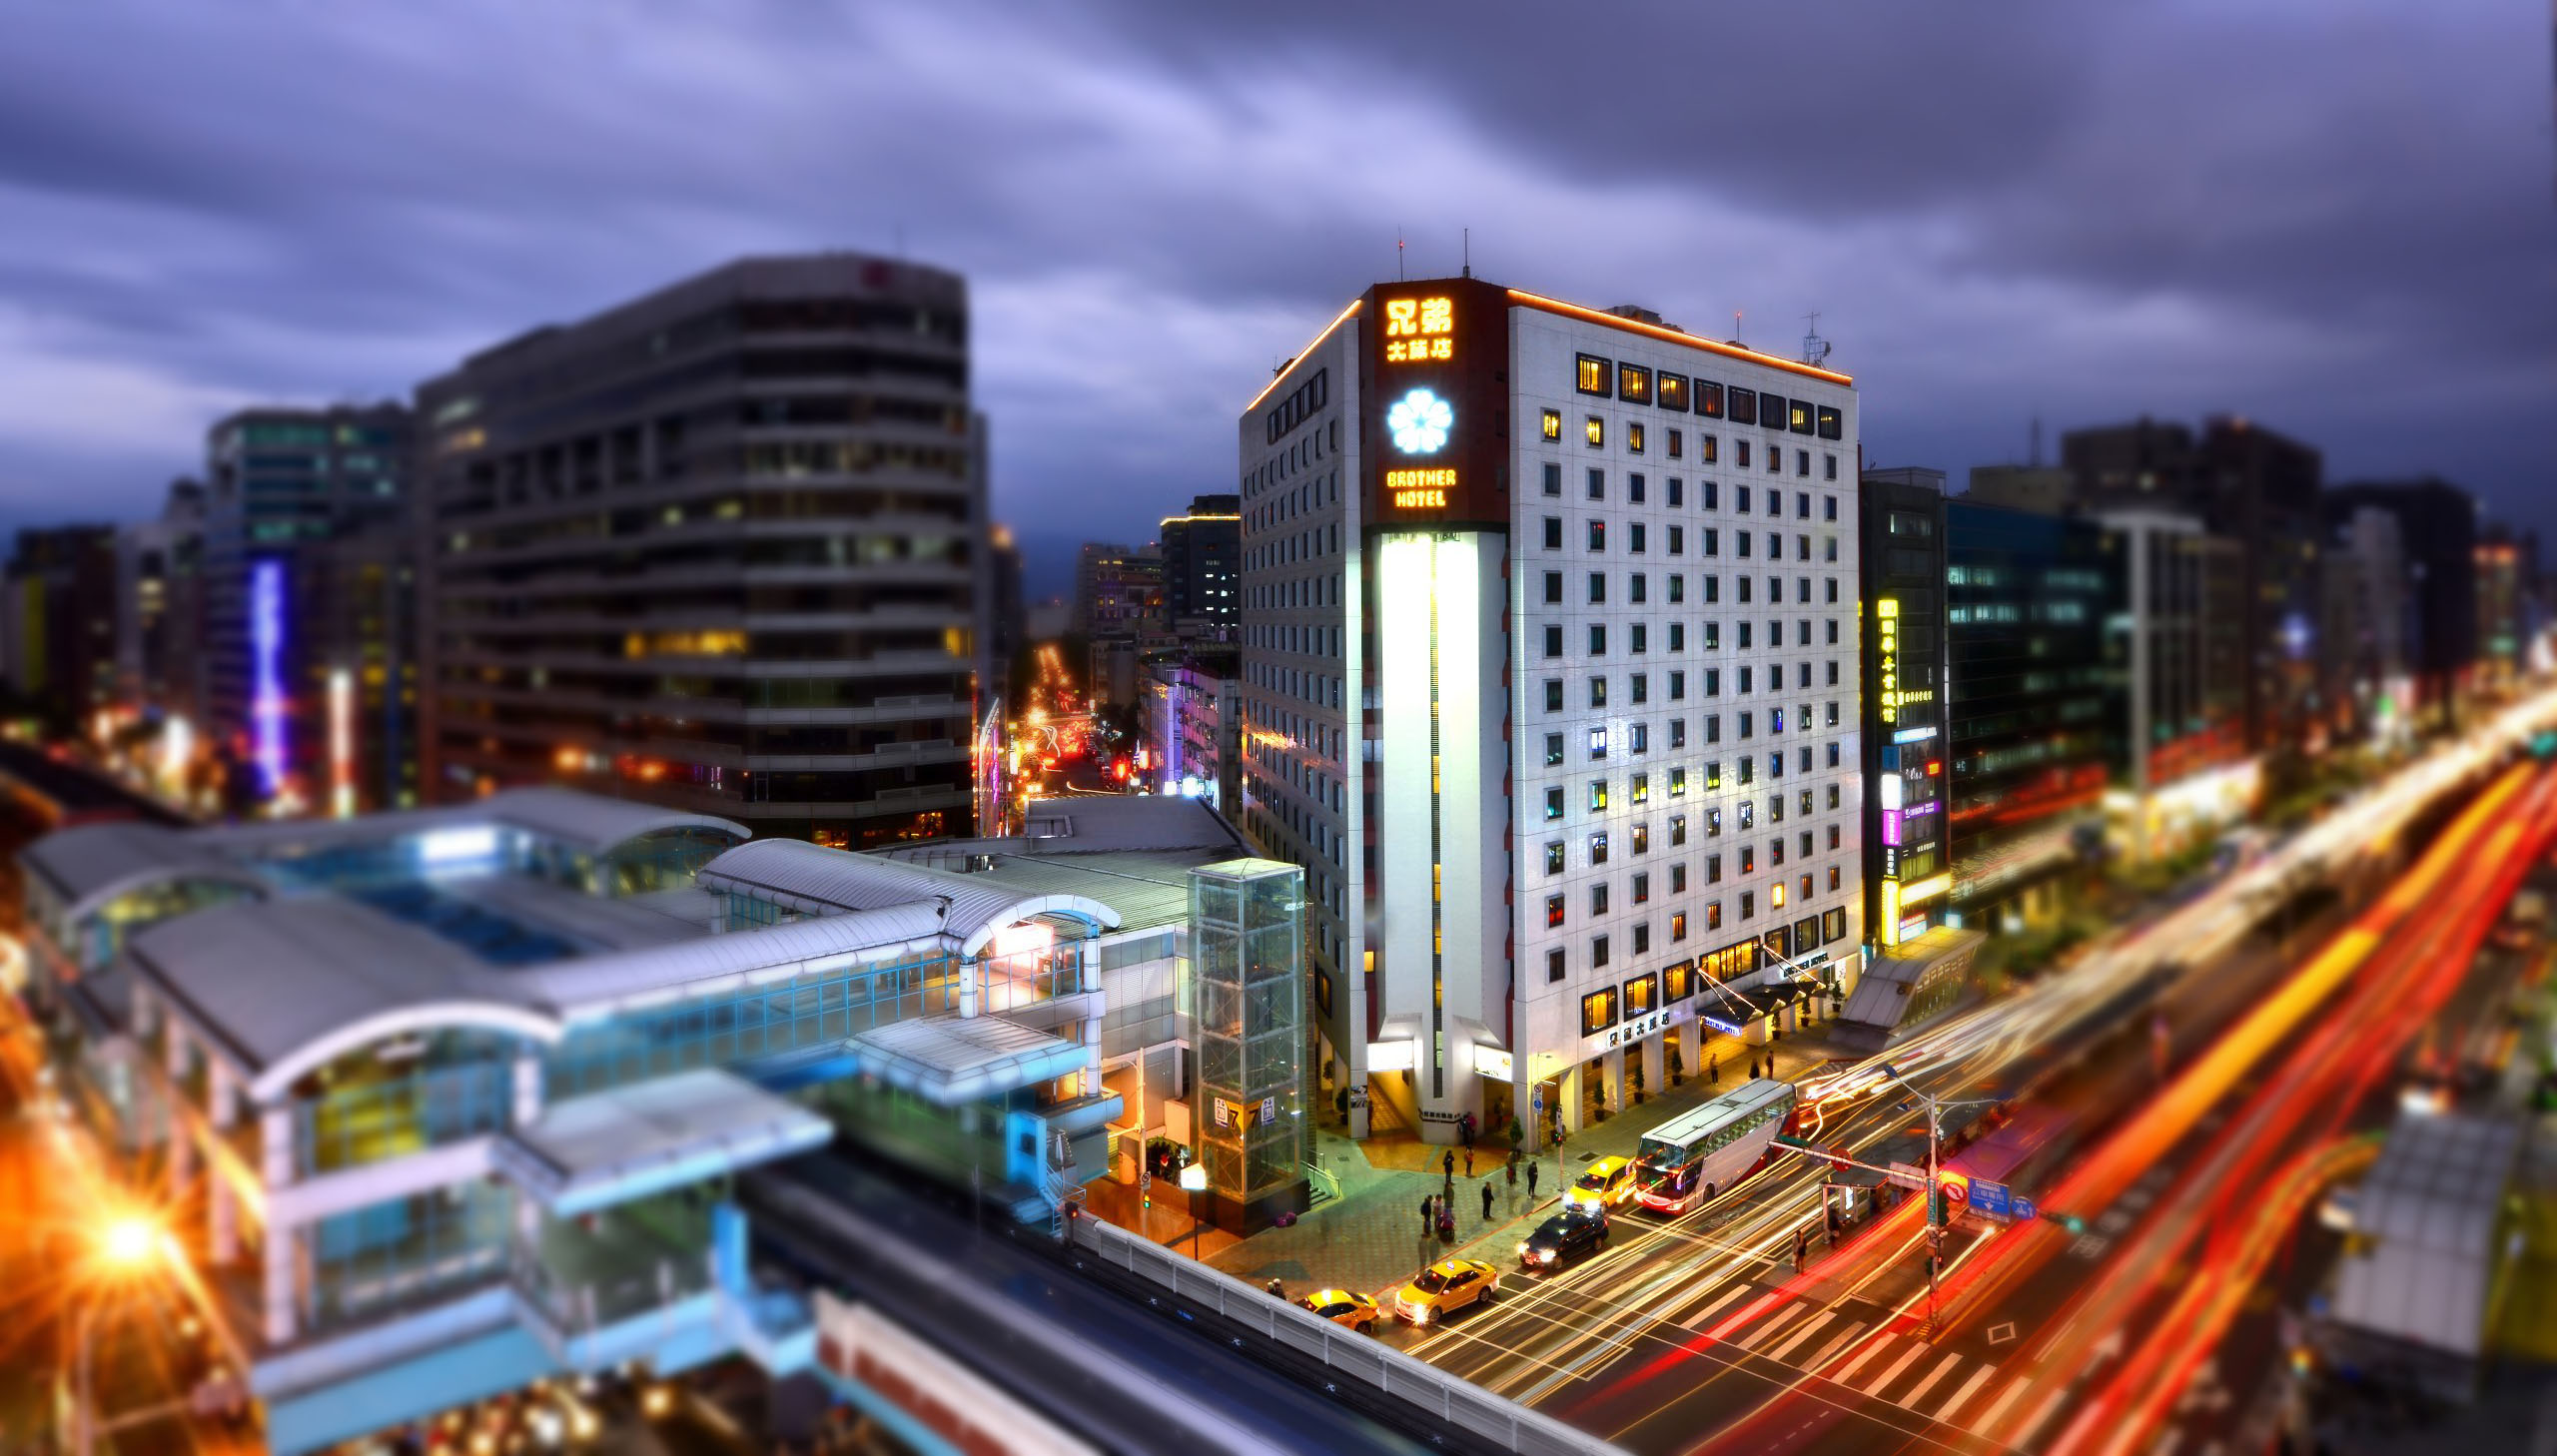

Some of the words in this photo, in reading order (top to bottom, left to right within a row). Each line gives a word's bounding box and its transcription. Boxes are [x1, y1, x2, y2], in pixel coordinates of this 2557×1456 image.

[1386, 298, 1452, 336] 兄弟
[1386, 469, 1456, 487] BROTHER
[1395, 490, 1446, 507] HOTEL
[1229, 1108, 1239, 1128] 7
[1249, 1107, 1261, 1128] 7
